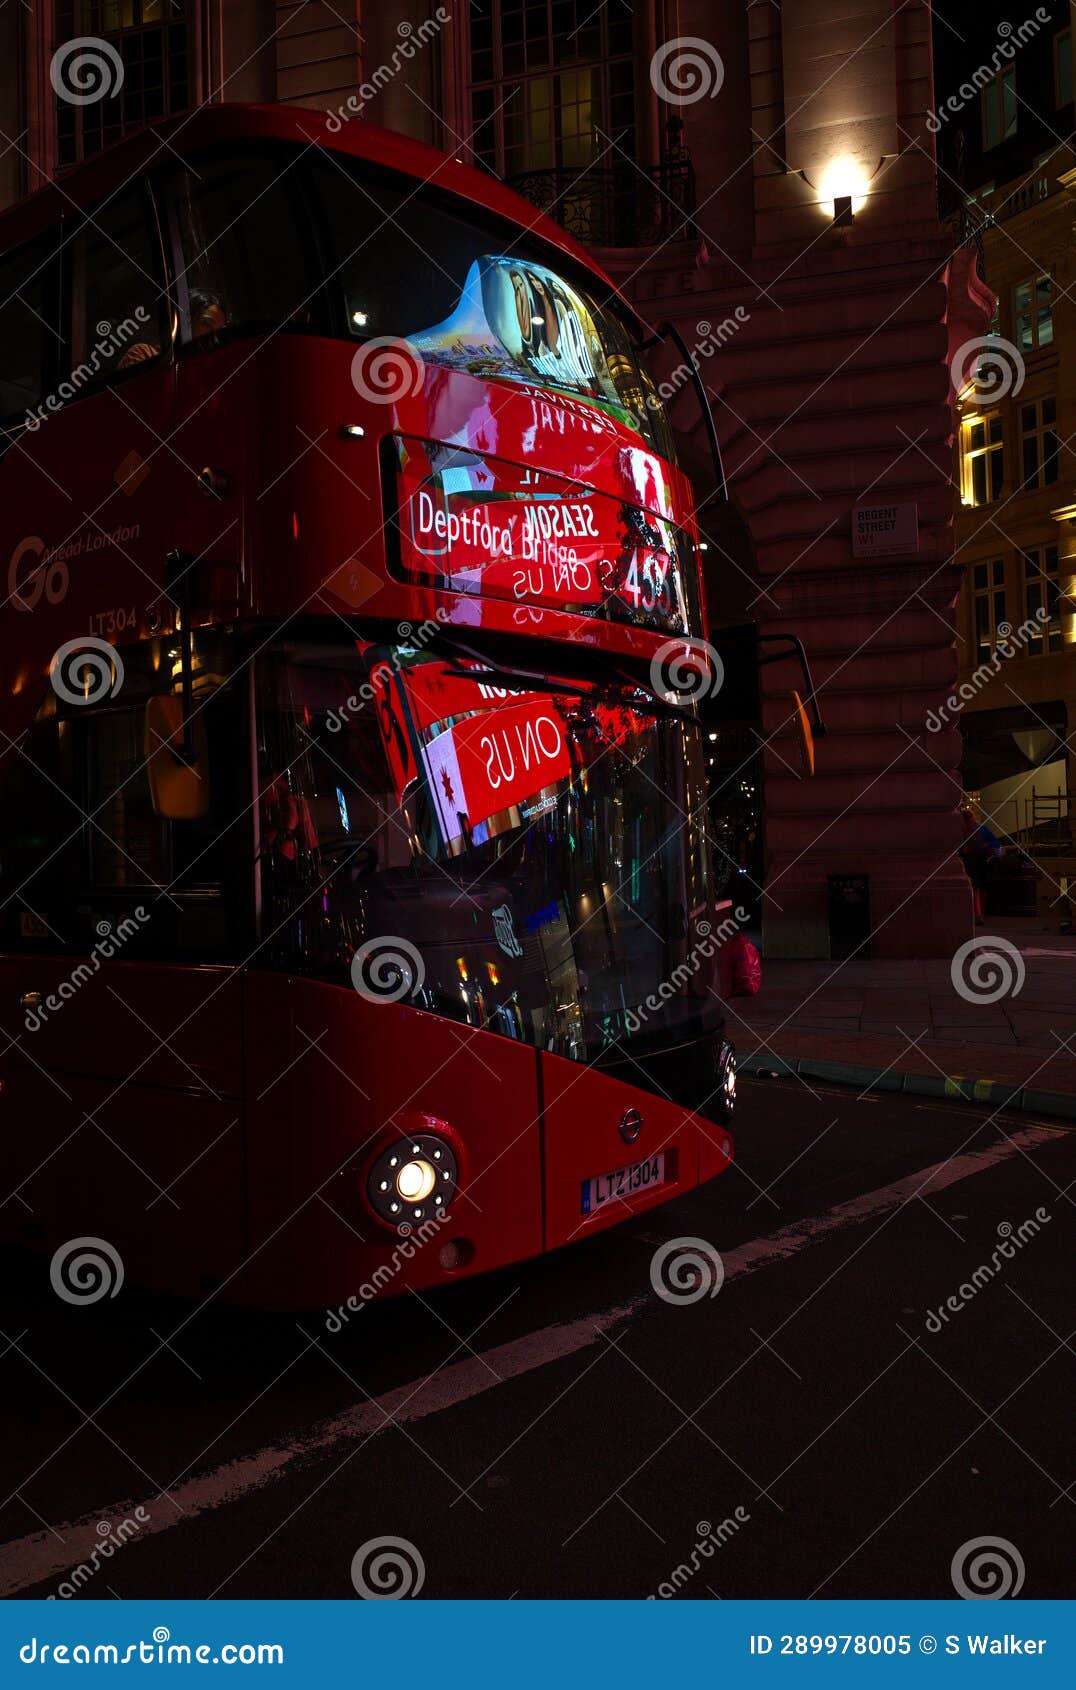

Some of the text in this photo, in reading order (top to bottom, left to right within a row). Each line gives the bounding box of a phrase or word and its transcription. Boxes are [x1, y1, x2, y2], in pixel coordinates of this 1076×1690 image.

[419, 491, 513, 555] Deptford
[858, 507, 898, 521] REGENT
[858, 520, 897, 533] STREET
[8, 535, 70, 612] Go
[89, 606, 137, 636] LT304
[596, 1158, 659, 1203] LTZ 1304
